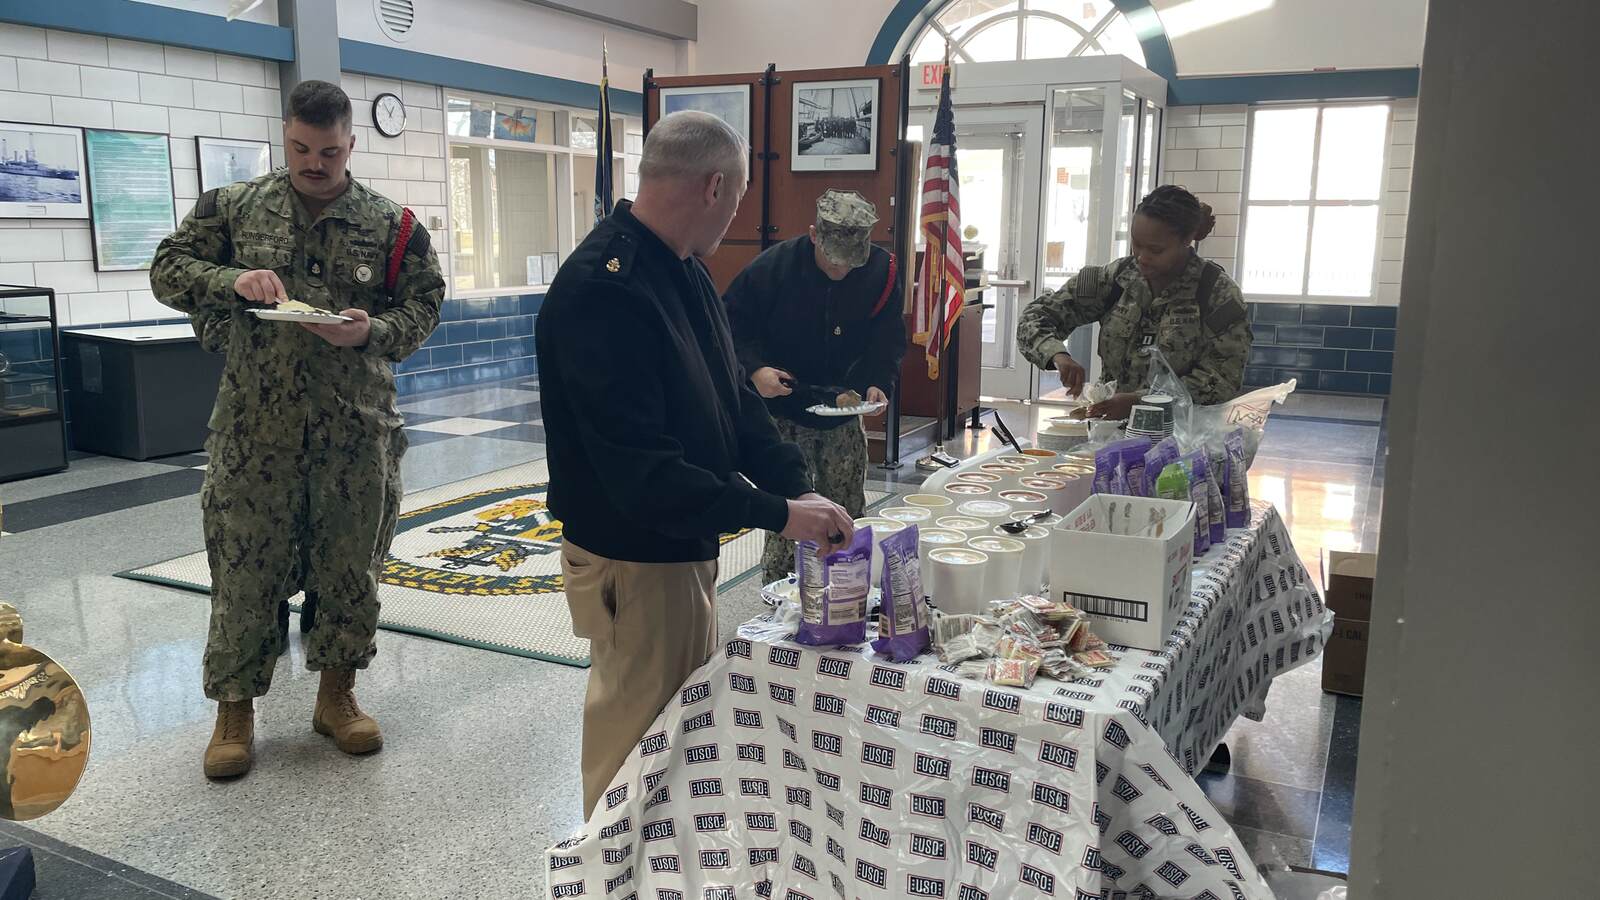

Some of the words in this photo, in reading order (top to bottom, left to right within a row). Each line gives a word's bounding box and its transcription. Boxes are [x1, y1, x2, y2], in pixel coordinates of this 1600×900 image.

[923, 64, 949, 85] EXI
[732, 641, 747, 656] USO
[775, 648, 793, 665] USO
[824, 659, 844, 675] USO
[736, 677, 750, 691] USO
[878, 669, 898, 686] USO
[686, 687, 704, 702] USO
[933, 679, 953, 696] USO
[819, 696, 838, 713] USO
[991, 691, 1013, 709] USO
[689, 713, 707, 729] USO
[740, 711, 755, 726] USO
[873, 710, 893, 726] USO
[1053, 702, 1076, 723] USO
[929, 718, 950, 736] USO
[644, 736, 663, 753] USO
[818, 735, 836, 751] USO
[987, 731, 1009, 749] USO
[691, 747, 711, 761] USO
[743, 746, 759, 760] USO
[868, 746, 888, 765] USO
[1049, 745, 1070, 766] USO
[921, 757, 942, 776] USO
[696, 781, 717, 794] USO
[981, 770, 1002, 788] USO
[746, 781, 764, 795] USO
[866, 787, 885, 805] USO
[1040, 786, 1063, 807] USO
[610, 788, 624, 806] USO
[918, 797, 939, 815] USO
[701, 816, 720, 829] USO
[751, 815, 769, 828] USO
[976, 807, 997, 826] USO
[605, 821, 625, 837] USO
[648, 823, 668, 838] USO
[795, 823, 807, 840] USO
[866, 822, 884, 843] USO
[1154, 817, 1174, 834] USO
[919, 838, 939, 856] USO
[1037, 828, 1055, 849] USO
[1124, 833, 1143, 856] USO
[554, 856, 575, 868] USO
[705, 853, 724, 866] USO
[973, 845, 992, 866] USO
[656, 858, 674, 871] USO
[861, 863, 879, 883] USO
[1028, 867, 1047, 890] USO
[1165, 865, 1182, 885] USO
[557, 883, 578, 897] USO
[710, 889, 728, 900] USO
[915, 879, 937, 894] USO
